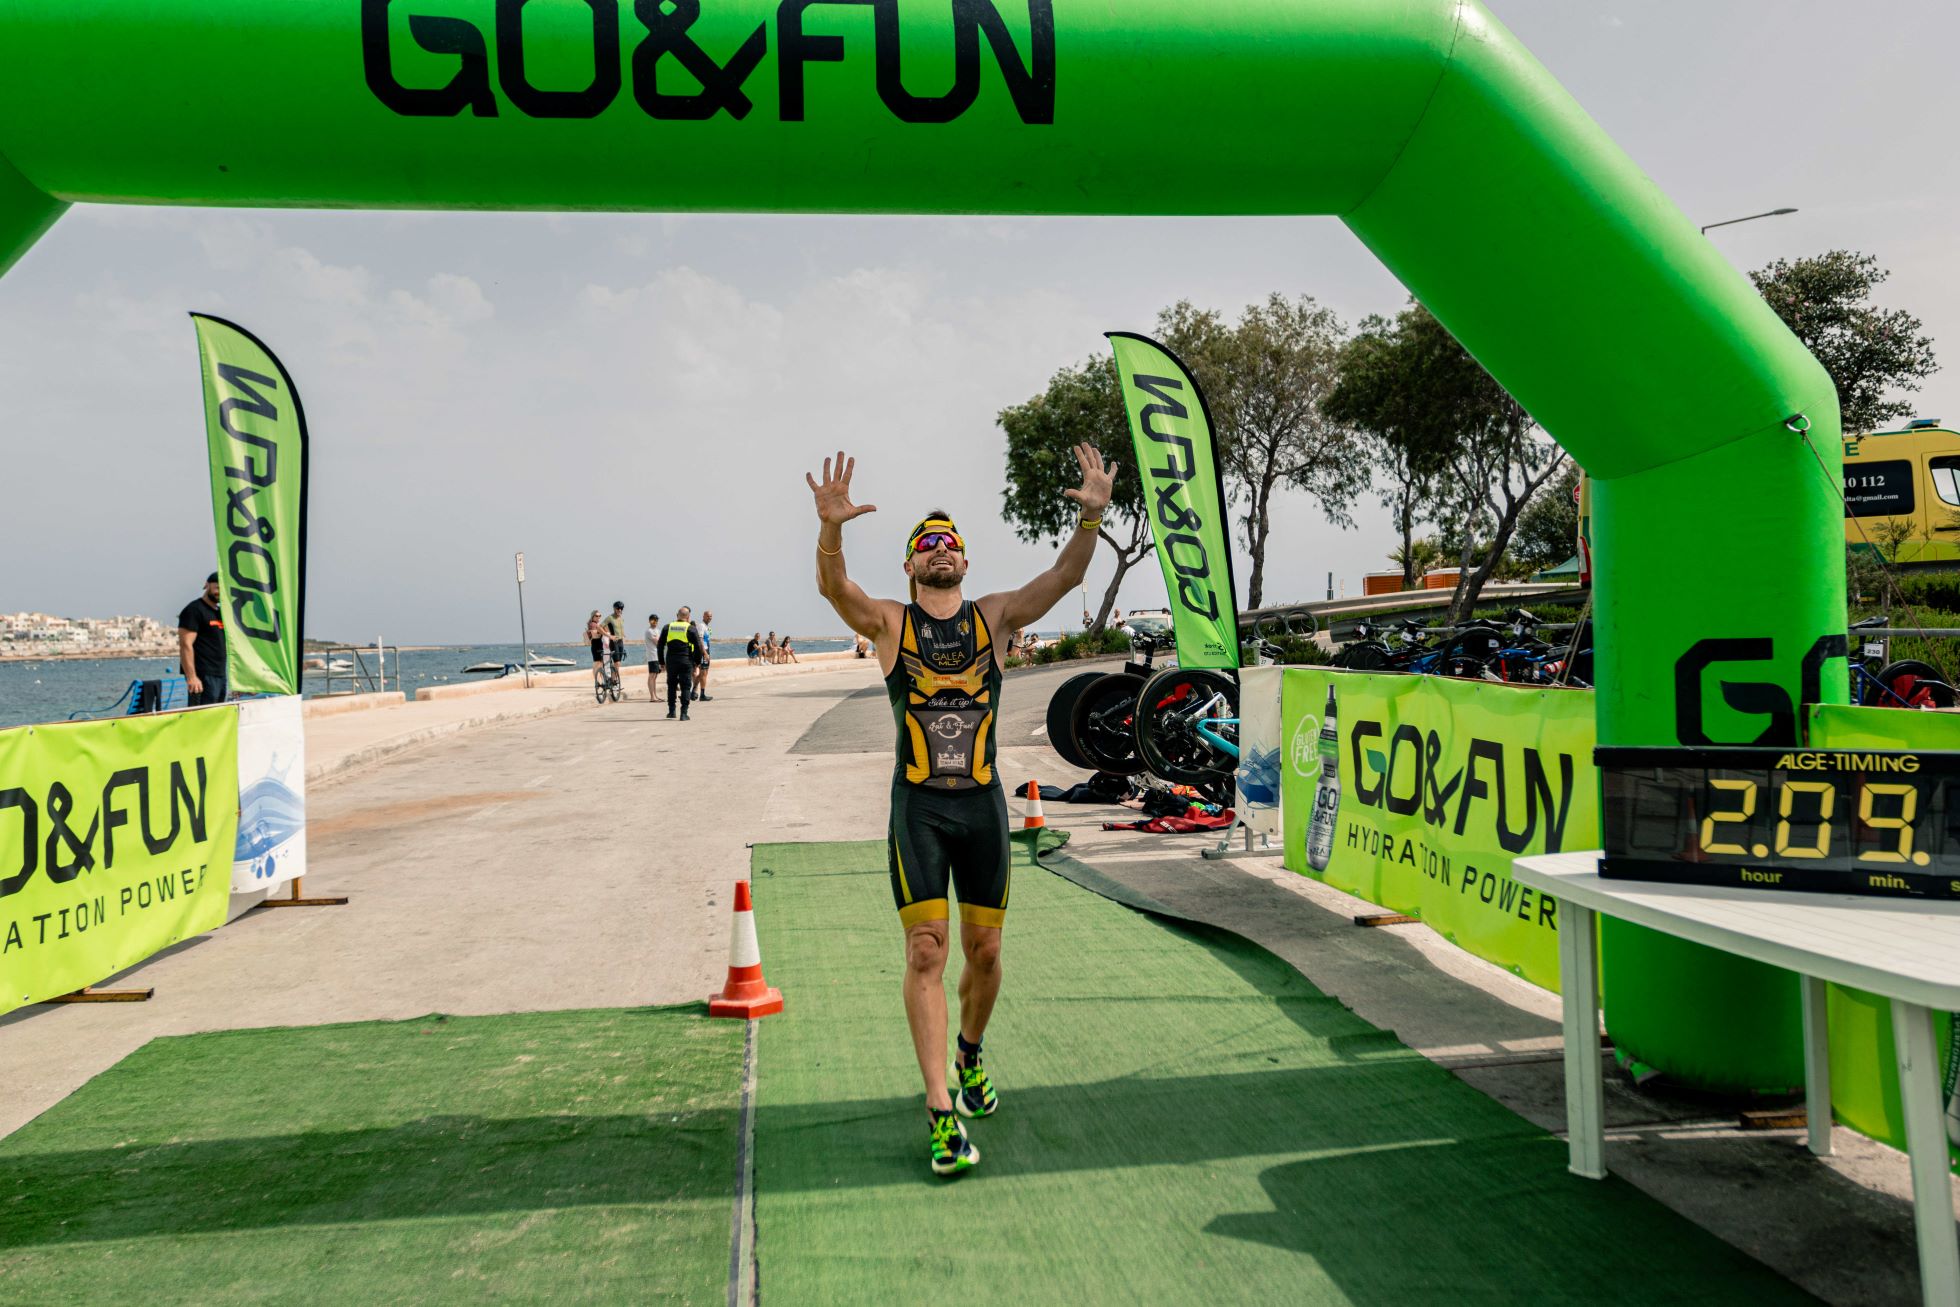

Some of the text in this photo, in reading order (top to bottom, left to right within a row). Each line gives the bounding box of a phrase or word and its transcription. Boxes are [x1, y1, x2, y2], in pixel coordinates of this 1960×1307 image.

[361, 0, 1055, 125] GO&FUN
[1861, 475, 1885, 488] 112
[1774, 752, 1921, 773] ALGE-TIMING
[1317, 786, 1337, 810] GO
[1350, 720, 1574, 854] GO&FUN
[1741, 868, 1783, 885] hour
[1868, 874, 1911, 890] min.
[1461, 865, 1558, 931] POWER
